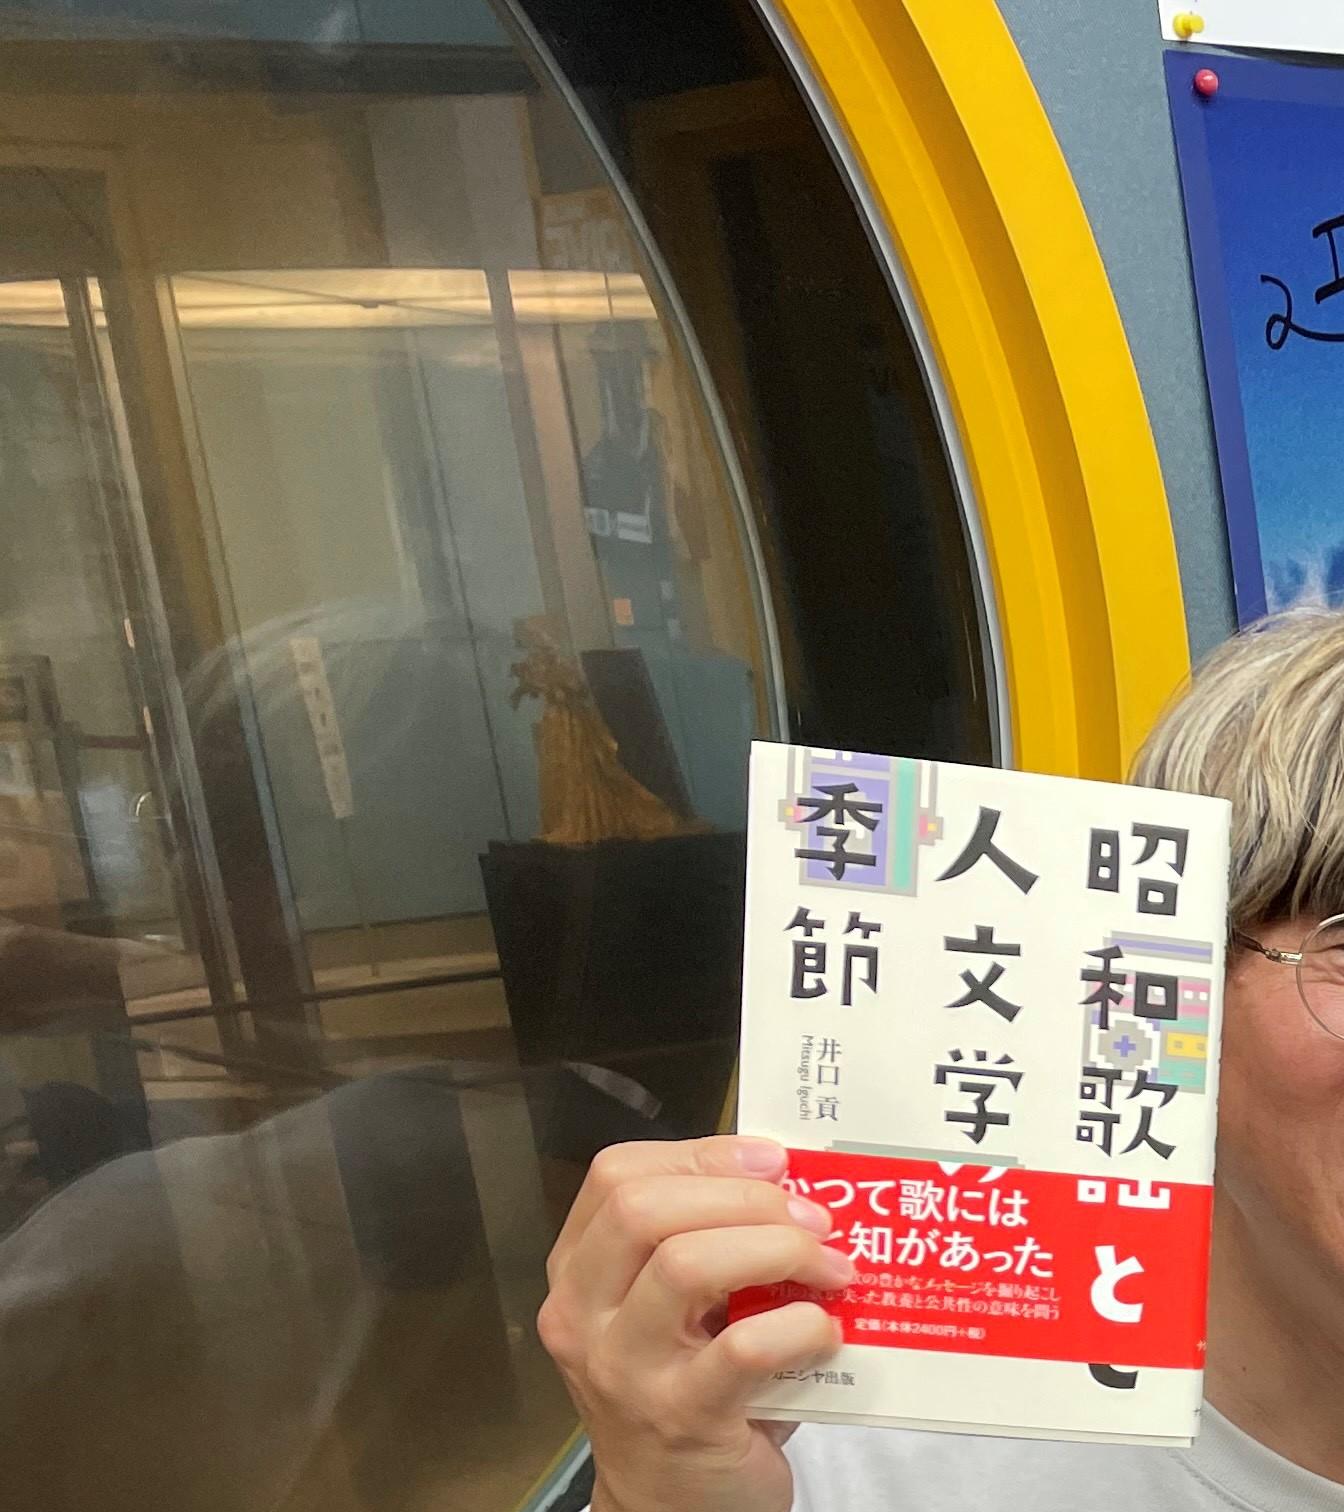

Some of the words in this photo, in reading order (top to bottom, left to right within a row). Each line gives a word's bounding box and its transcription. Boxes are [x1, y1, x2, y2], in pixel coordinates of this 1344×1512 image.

[783, 782, 884, 1007] 季節
[933, 805, 1041, 1184] 人文学
[816, 1037, 843, 1086] 井口
